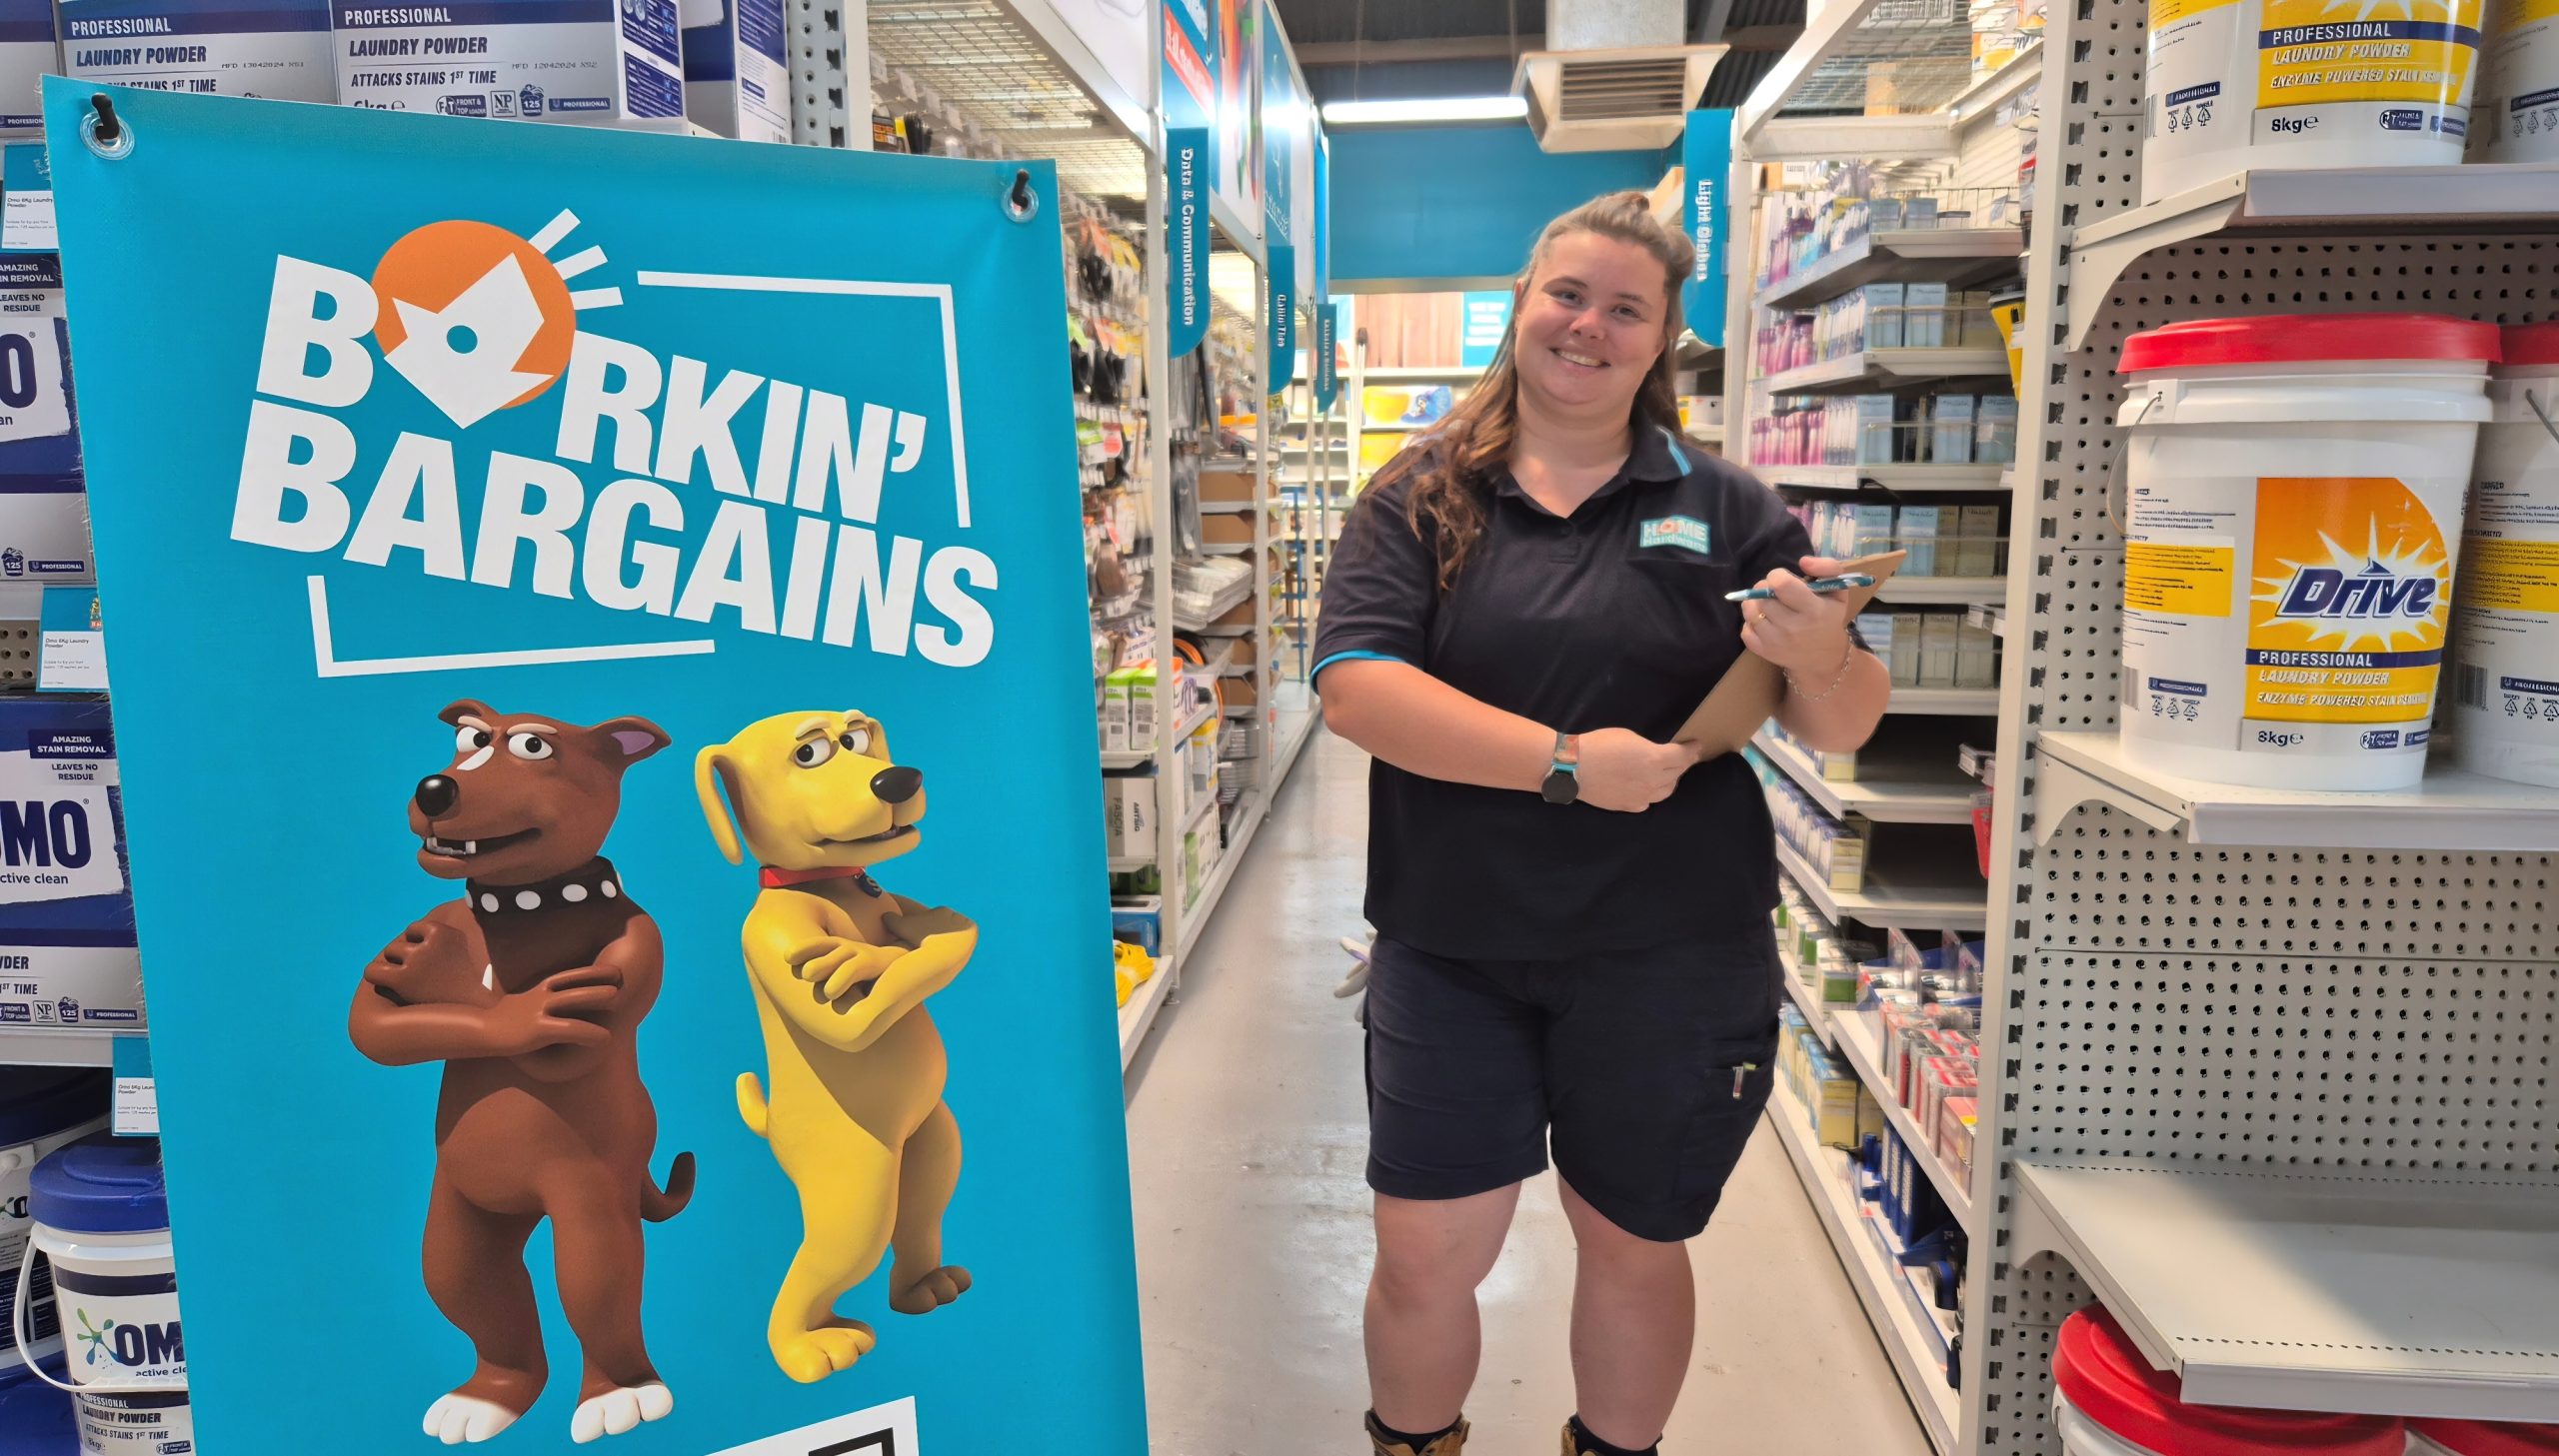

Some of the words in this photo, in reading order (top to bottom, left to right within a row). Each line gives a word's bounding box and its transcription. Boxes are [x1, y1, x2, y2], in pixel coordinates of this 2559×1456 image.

[344, 7, 452, 26] PROFESSIONAL
[71, 17, 172, 36] PROFESSIONAL
[2272, 23, 2392, 45] PROFESSIONAL
[350, 38, 419, 57] LAUNDRY
[424, 36, 488, 54] POWDER
[2272, 44, 2345, 65] LAUNDRY
[2351, 43, 2411, 59] POWDER
[76, 48, 141, 67] LAUNDRY
[146, 46, 207, 64] POWDER
[190, 79, 217, 92] TIME
[351, 71, 402, 88] ATTACKS
[406, 71, 446, 87] STAINS
[450, 71, 465, 86] 1ST
[469, 70, 497, 84] TIME
[1695, 180, 1713, 223] Light
[1182, 204, 1196, 326] Communication
[11, 274, 54, 283] REMOVAL
[230, 399, 999, 669] BARGAINS
[2275, 557, 2437, 619] Drive
[2259, 652, 2373, 668] PROFESSIONAL
[2259, 670, 2330, 685] LAUNDRY
[2332, 672, 2390, 686] POWDER
[52, 735, 92, 744] AMAZING
[0, 799, 92, 869] MO
[0, 872, 31, 885] ctive
[34, 871, 69, 885] clean
[14, 983, 38, 995] TIME
[36, 1003, 52, 1015] NP
[115, 1322, 185, 1366] OM
[135, 1368, 169, 1377] active
[82, 1405, 116, 1423] LAUNDRY
[118, 1412, 161, 1424] POWDER
[86, 1423, 108, 1437] ATTACKS
[110, 1429, 133, 1440] STAINS
[149, 1430, 169, 1439] TIME
